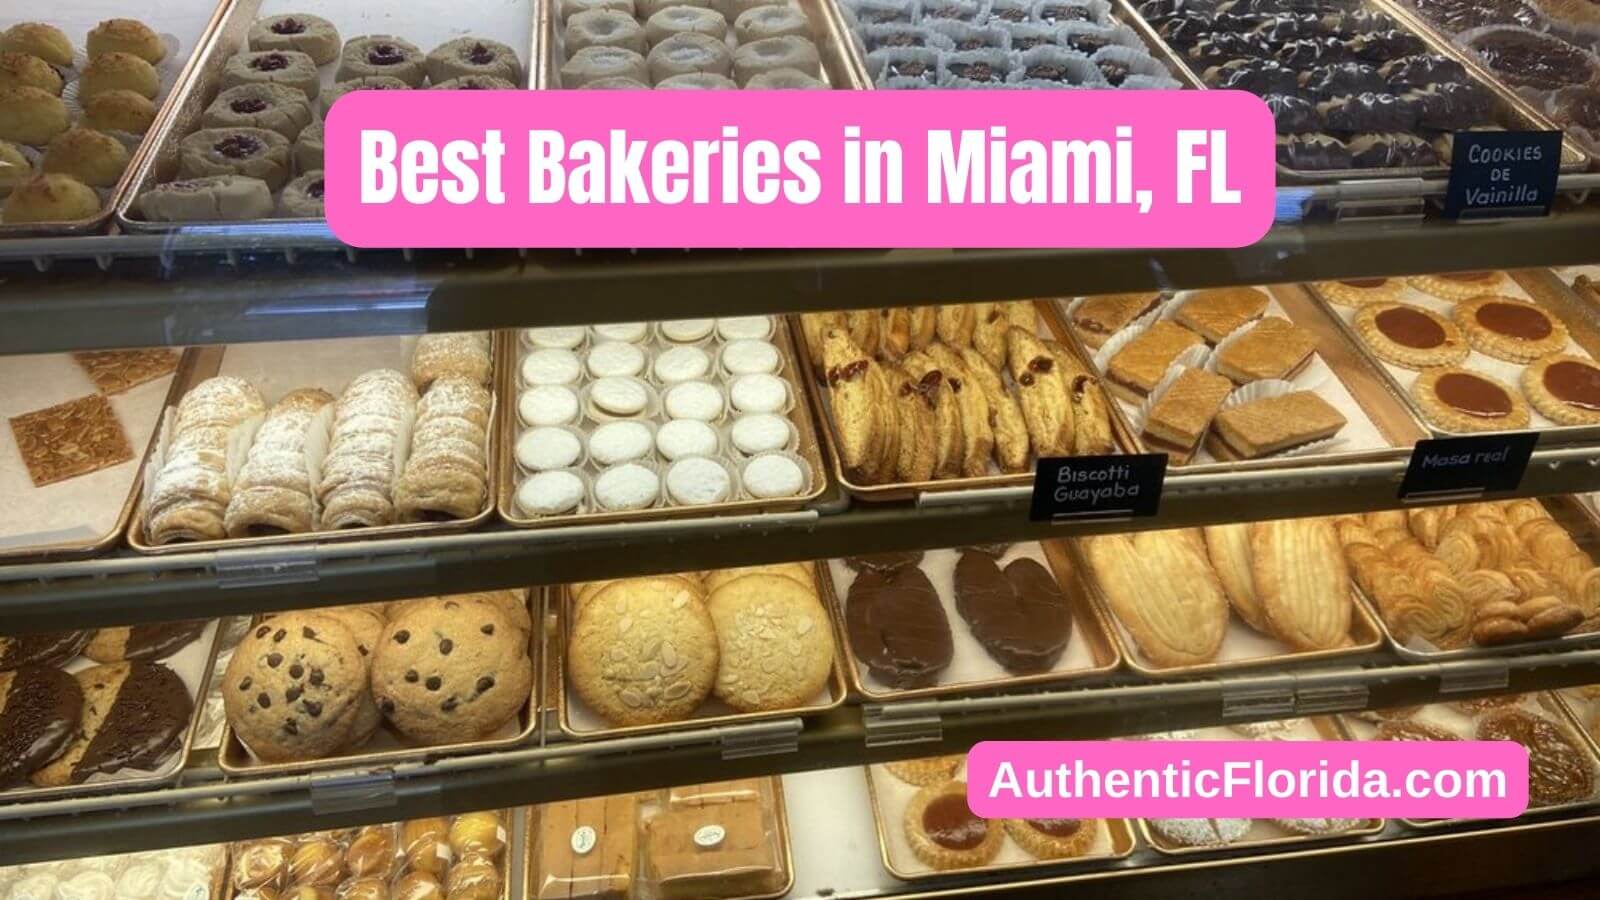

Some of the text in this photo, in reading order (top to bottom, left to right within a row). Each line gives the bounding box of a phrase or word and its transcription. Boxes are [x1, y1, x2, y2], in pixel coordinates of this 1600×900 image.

[1490, 168, 1511, 181] DE
[1465, 184, 1538, 205] Vainilla
[1421, 445, 1510, 469] Masa real
[1057, 465, 1130, 483] Biscotti
[1054, 482, 1140, 505] Guayaba
